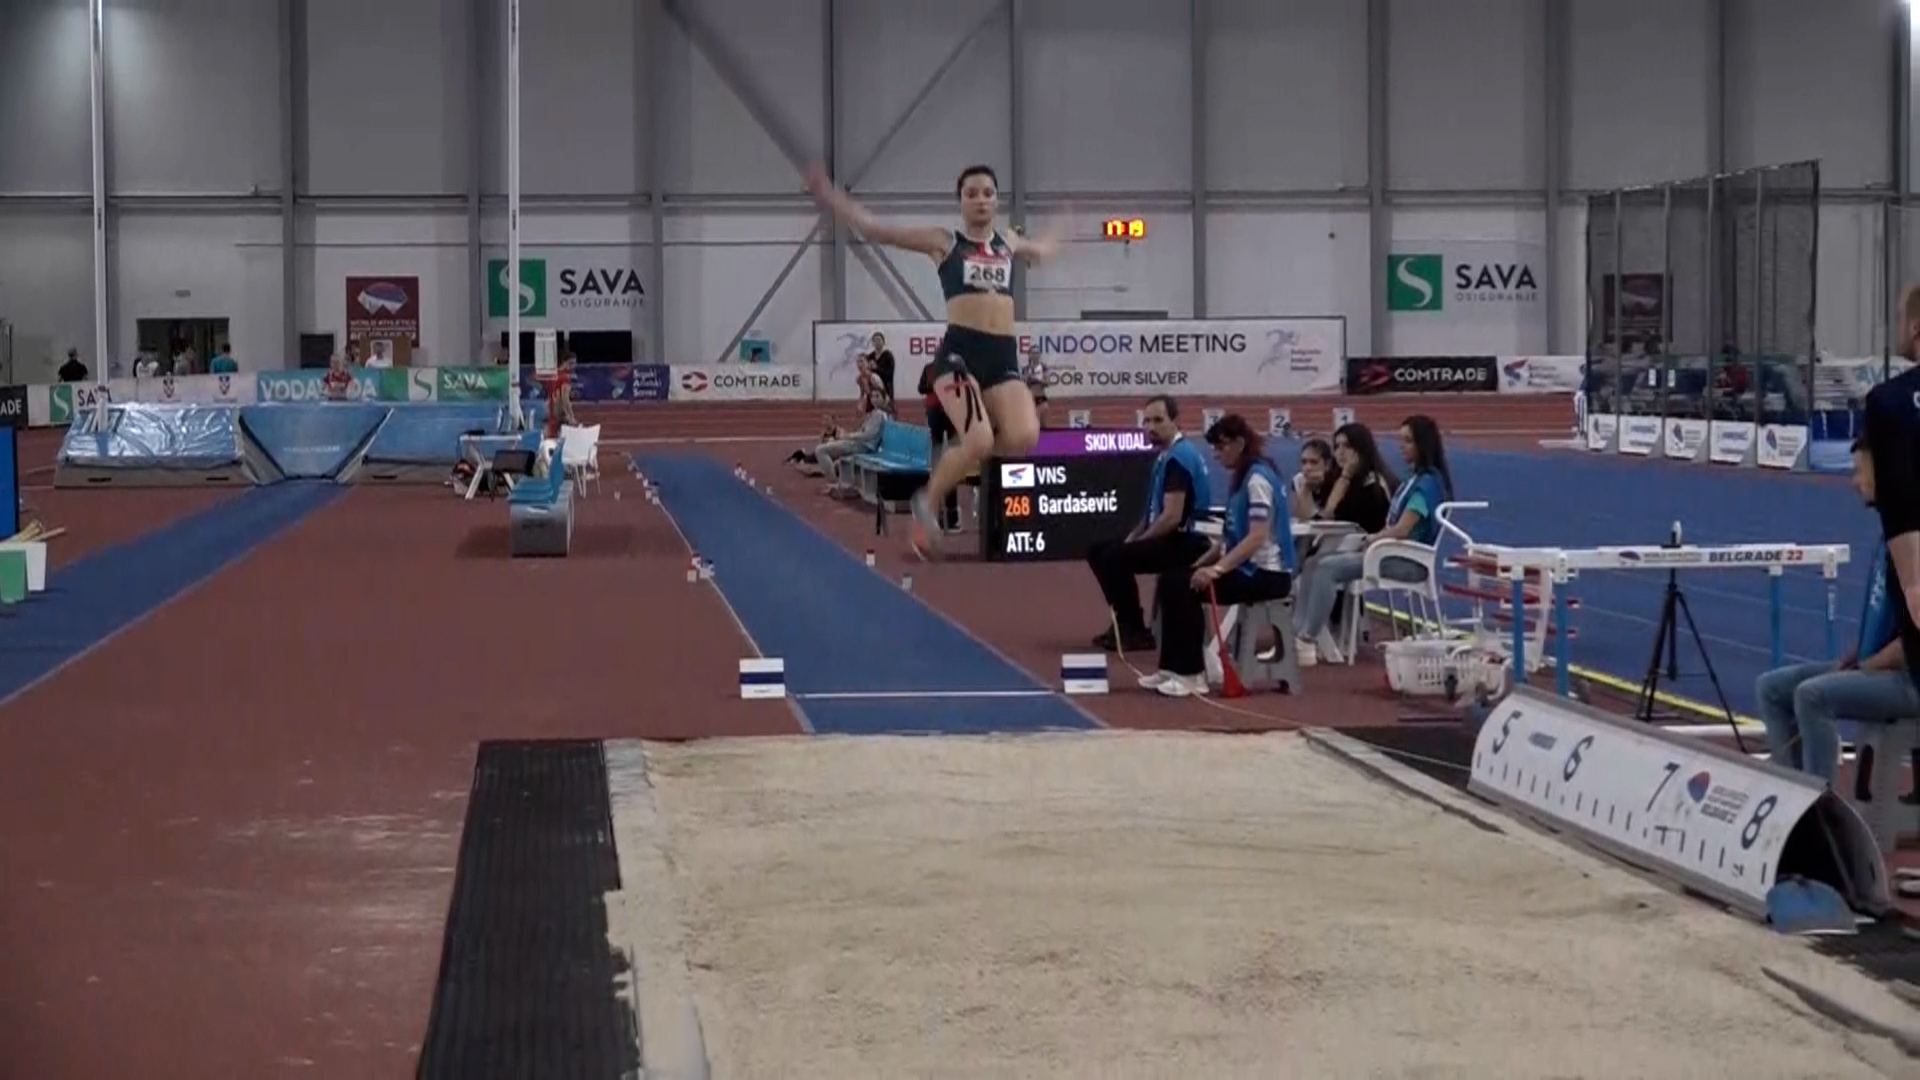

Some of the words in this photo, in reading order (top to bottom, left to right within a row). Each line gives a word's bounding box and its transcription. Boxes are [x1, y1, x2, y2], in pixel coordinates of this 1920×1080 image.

[560, 268, 645, 295] SAVA
[970, 264, 1006, 283] 268
[1456, 263, 1538, 290] SAVA
[560, 298, 645, 308] OSIGURANJE
[1038, 334, 1133, 354] INDOOR
[1139, 333, 1247, 353] MEETING
[443, 373, 488, 390] SAVA
[713, 373, 801, 388] COMTRADE
[1088, 371, 1131, 385] TOUR
[1134, 371, 1188, 385] SILVER
[1393, 367, 1488, 382] COMTRADE
[77, 387, 113, 407] SA
[260, 377, 378, 401] VODAVDA
[1274, 410, 1286, 429] 2
[1084, 432, 1117, 451] SKOK
[1036, 466, 1067, 484] VNS
[1004, 495, 1031, 517] 268
[1038, 489, 1118, 515] Gardašević
[1006, 531, 1034, 553] ATT:
[1035, 531, 1046, 551] 6
[1708, 550, 1782, 563] BELGRADE
[1786, 550, 1804, 561] 22
[1492, 709, 1523, 755] 5
[1563, 734, 1595, 783] 6
[1645, 761, 1682, 813] 7
[1741, 794, 1778, 850] 8
